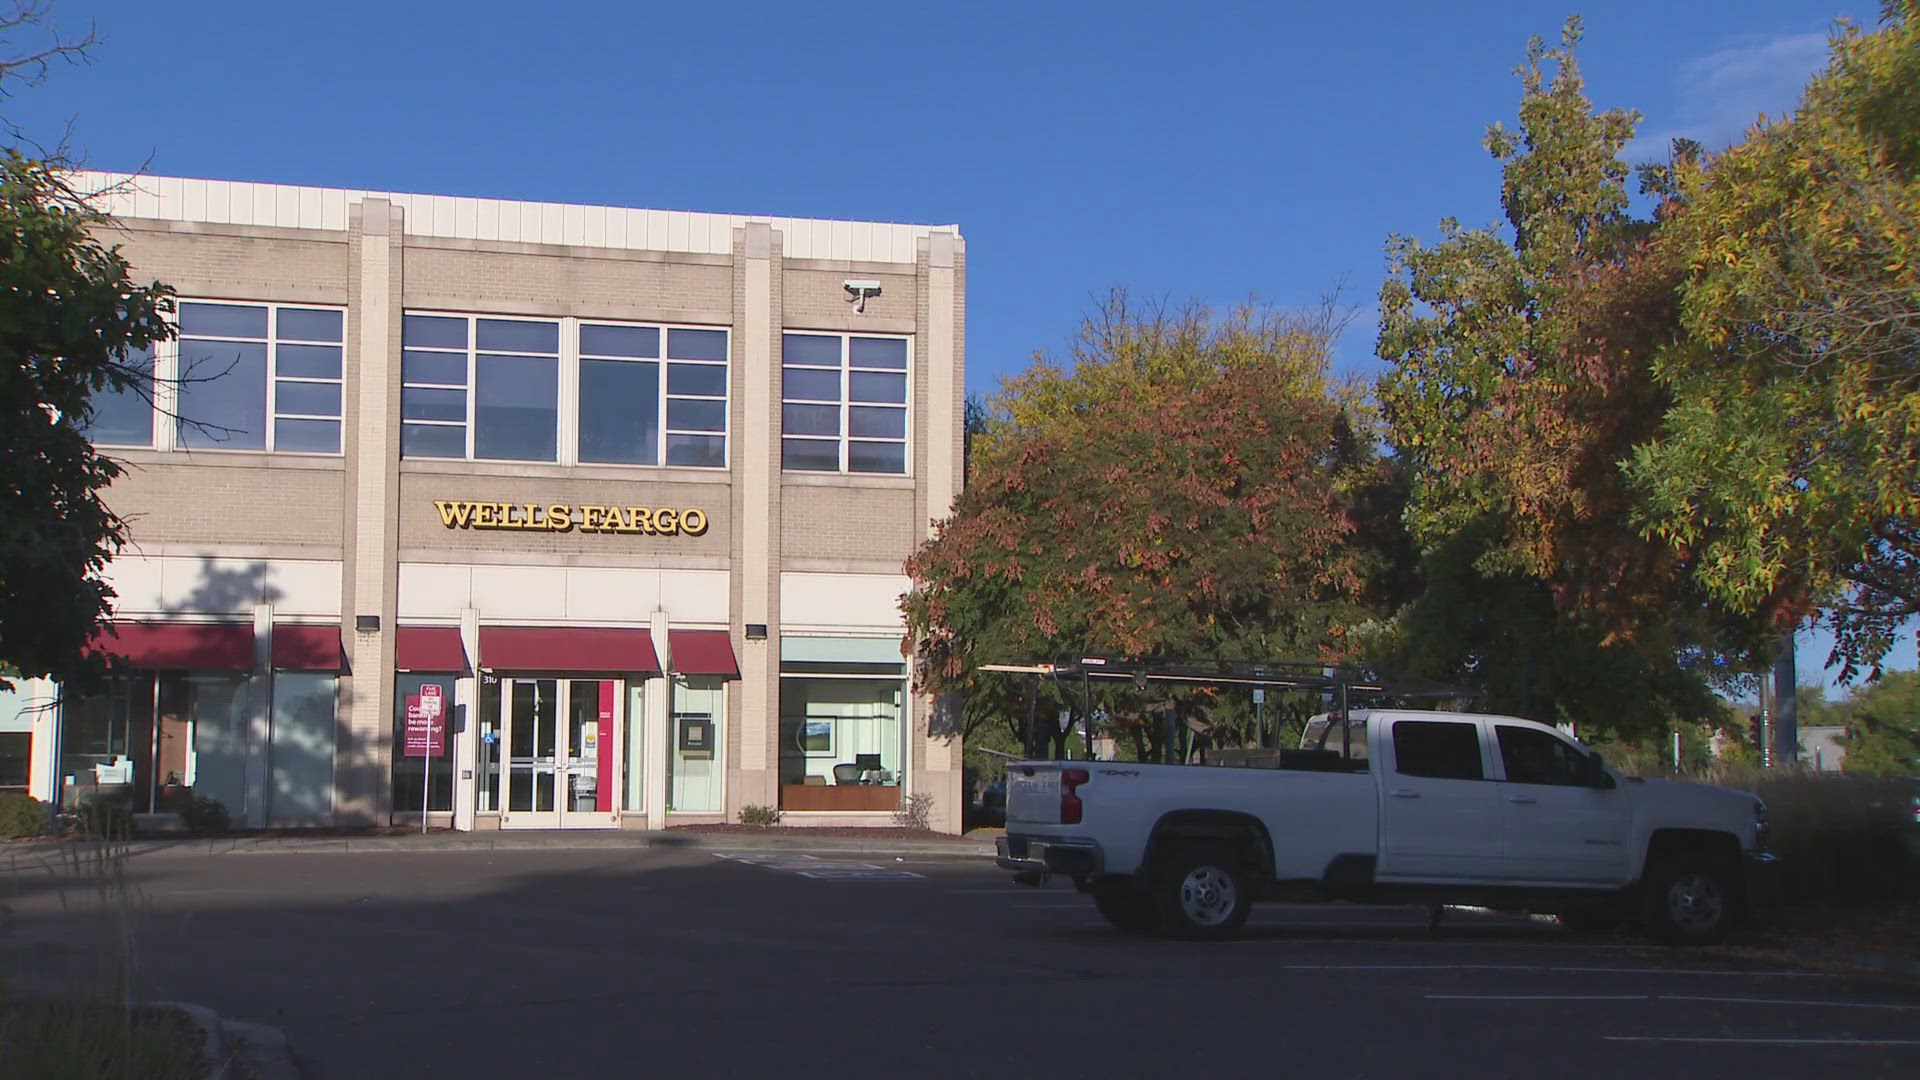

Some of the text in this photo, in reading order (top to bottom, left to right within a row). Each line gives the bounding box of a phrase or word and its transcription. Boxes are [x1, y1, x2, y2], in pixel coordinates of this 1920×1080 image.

[434, 500, 708, 535] WELLS FARGO
[483, 676, 498, 684] 310
